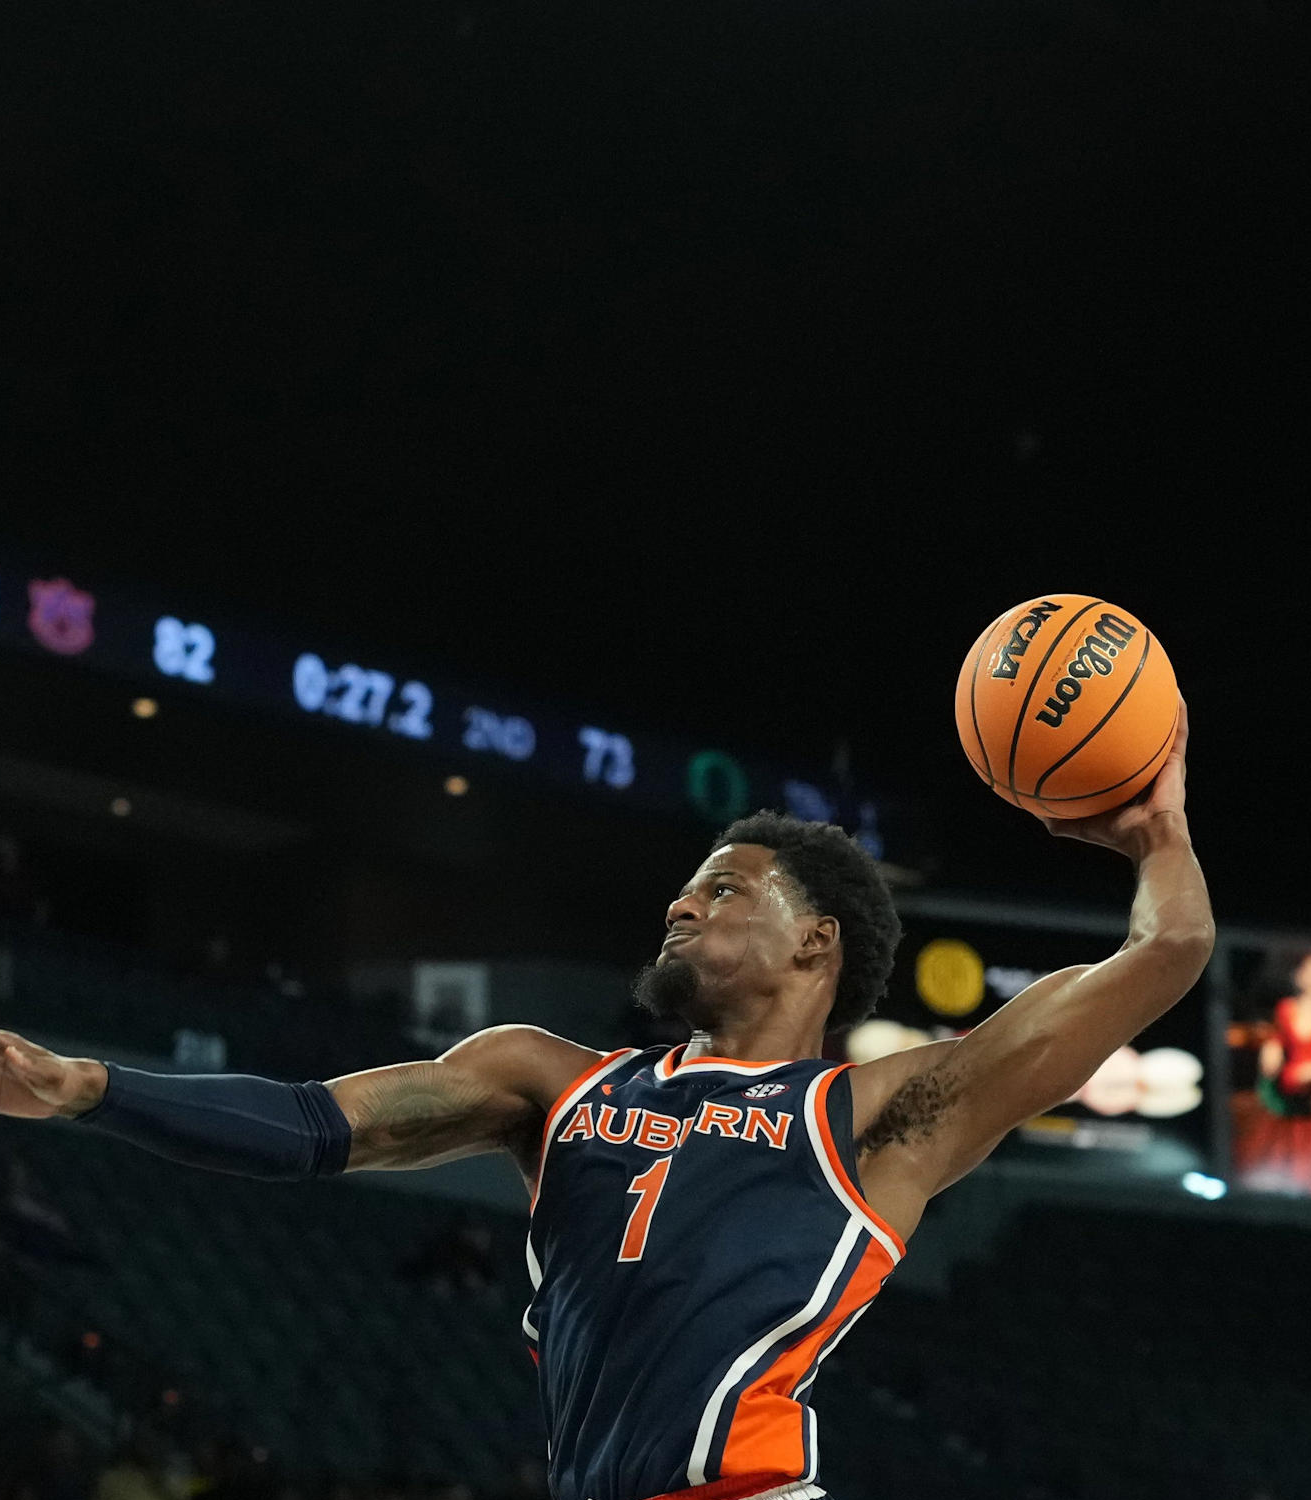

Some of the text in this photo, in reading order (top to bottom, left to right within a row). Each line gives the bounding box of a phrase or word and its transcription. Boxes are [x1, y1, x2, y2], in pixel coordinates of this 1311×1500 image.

[153, 616, 215, 684] 82
[991, 601, 1063, 680] NCAA
[1035, 613, 1138, 729] Wilson
[293, 652, 434, 741] 0:27.2
[578, 727, 635, 790] 73
[744, 1083, 788, 1099] SEC
[617, 1154, 673, 1263] 1
